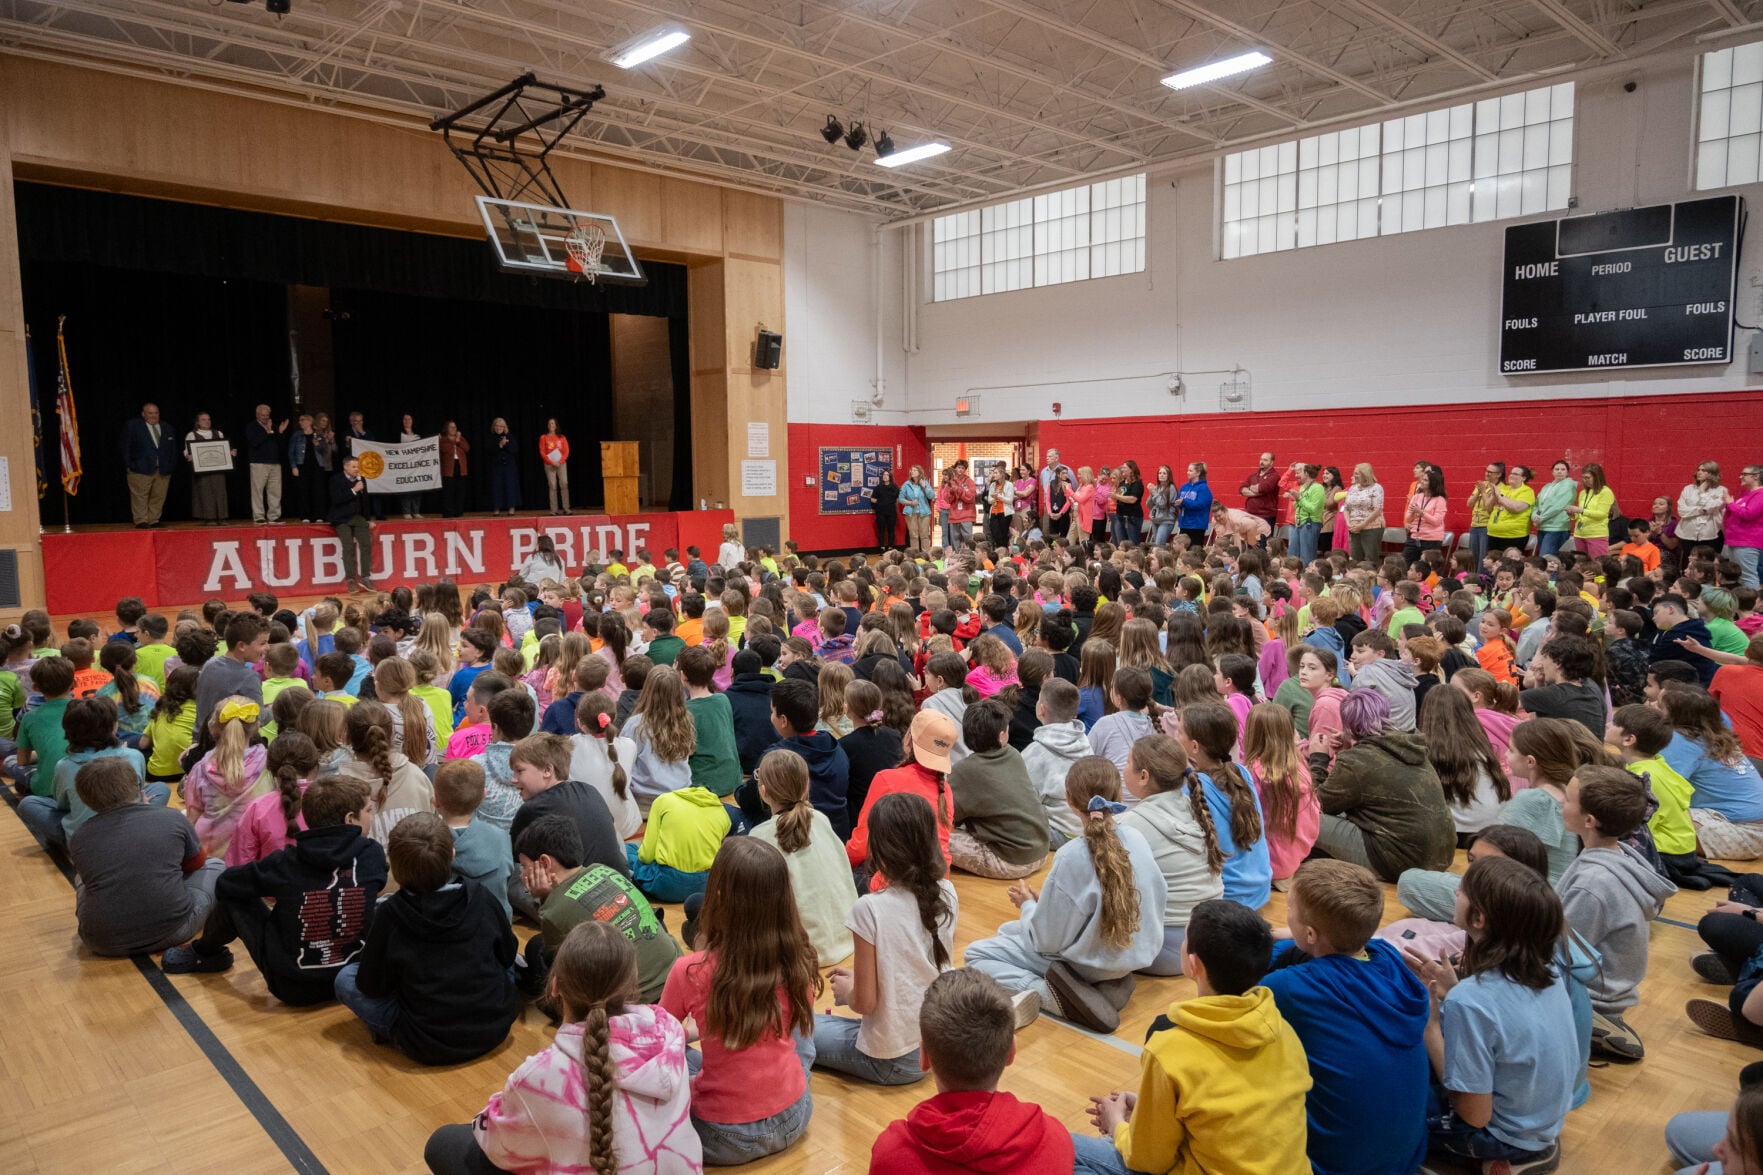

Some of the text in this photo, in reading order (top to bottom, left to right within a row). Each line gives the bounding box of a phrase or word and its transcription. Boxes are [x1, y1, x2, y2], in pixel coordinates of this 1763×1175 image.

[1664, 242, 1723, 264] GUEST
[1515, 261, 1559, 280] HOME
[1591, 261, 1632, 276] PERIOD
[1686, 301, 1725, 315] FOULS
[1574, 308, 1648, 325] PLAYER FOUL
[1505, 317, 1538, 330] FOULS
[1588, 353, 1627, 366] MATCH
[1683, 347, 1723, 360] SCORE
[1503, 359, 1537, 371] SCORE
[401, 444, 438, 456] HAMPSHIRE
[388, 458, 439, 470] EXCELLENCE IN
[395, 474, 433, 485] EDUCATION
[203, 522, 650, 592] AUBURN PRIDE
